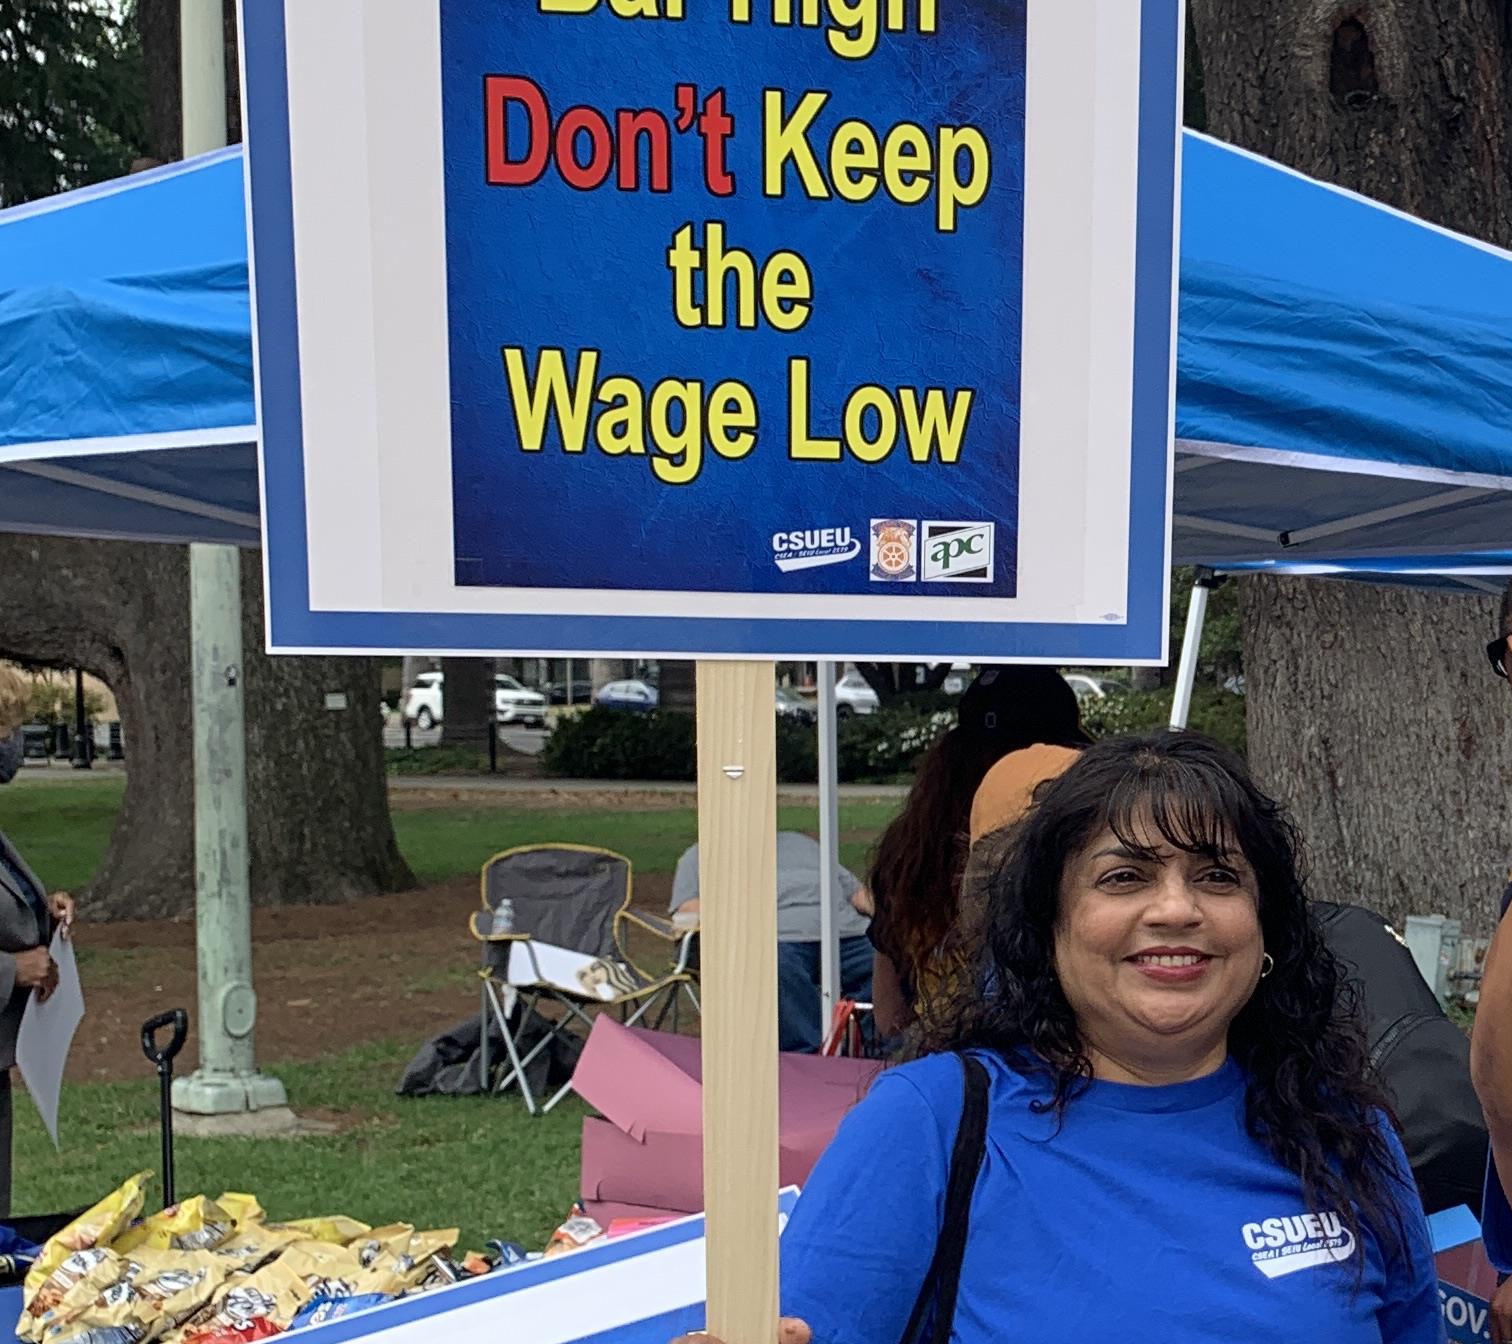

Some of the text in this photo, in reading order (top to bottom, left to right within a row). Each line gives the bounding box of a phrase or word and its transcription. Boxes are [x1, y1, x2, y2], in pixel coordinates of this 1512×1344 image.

[483, 74, 991, 232] Don't Keep
[669, 222, 813, 331] the
[504, 346, 972, 485] Wage Low
[772, 526, 851, 552] CSUEU
[930, 533, 985, 570] apc
[1242, 1211, 1342, 1249] CSUEU
[1441, 1287, 1491, 1340] OV.
